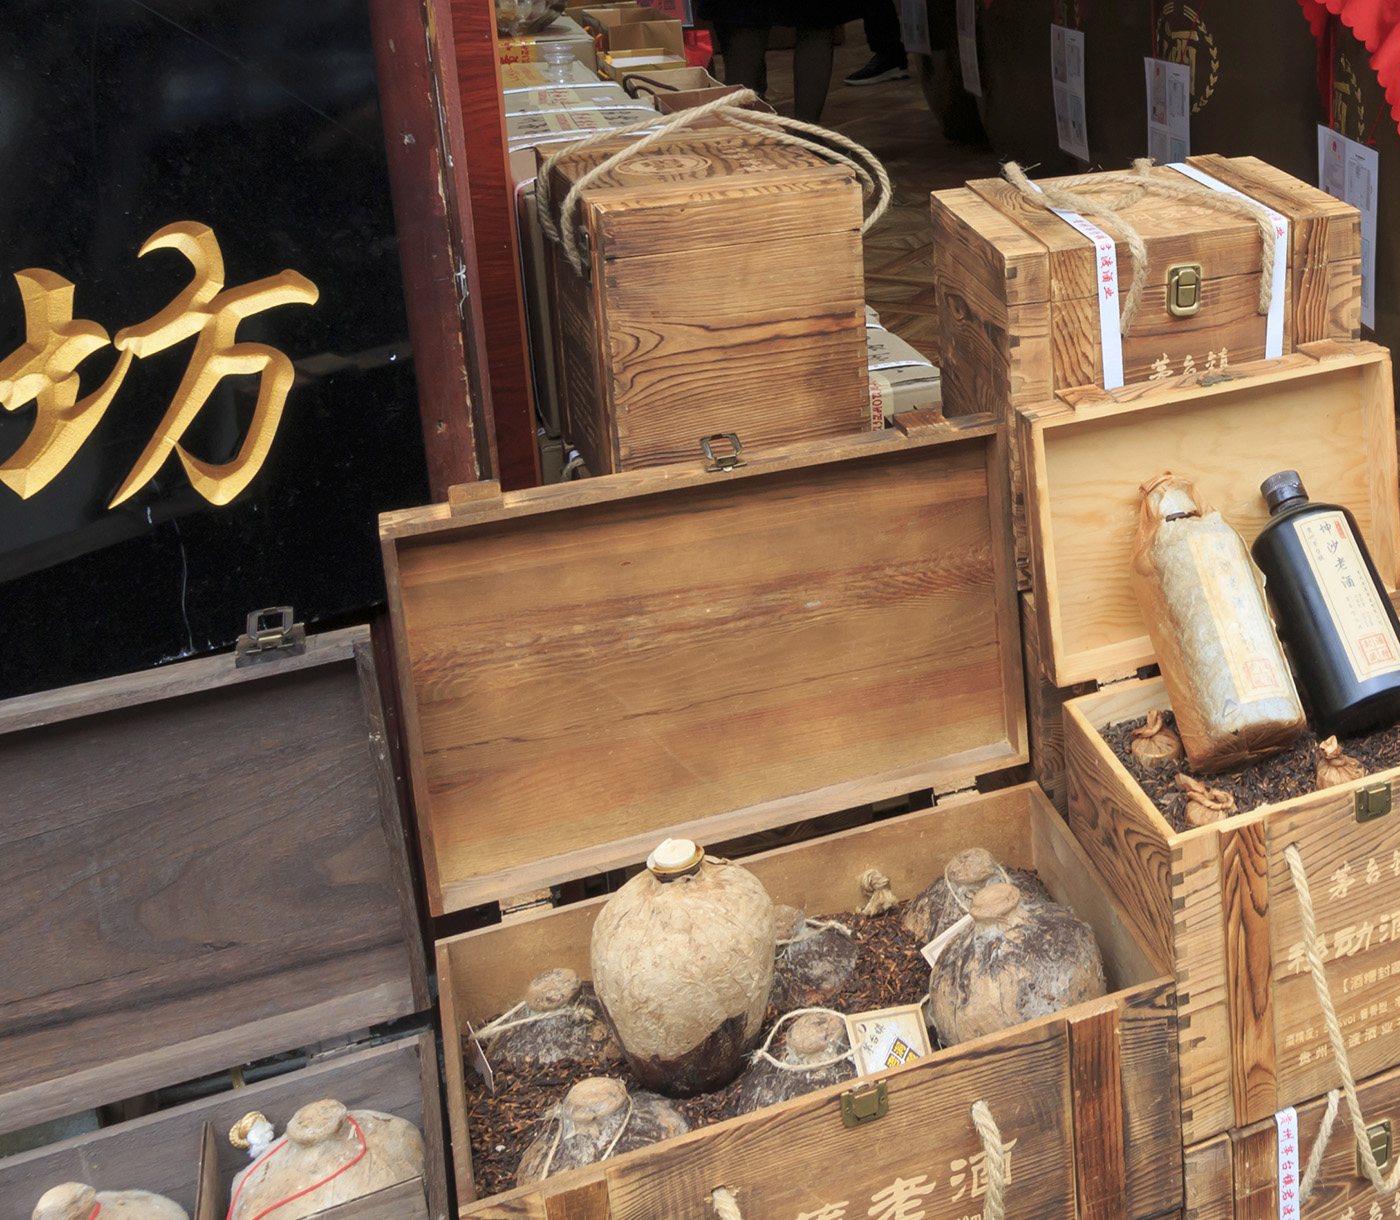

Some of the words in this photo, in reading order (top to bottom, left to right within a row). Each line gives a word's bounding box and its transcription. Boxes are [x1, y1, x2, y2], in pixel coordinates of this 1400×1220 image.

[0, 220, 320, 509] 坊
[1279, 1110, 1297, 1220] 贵州茅台镇君渡
